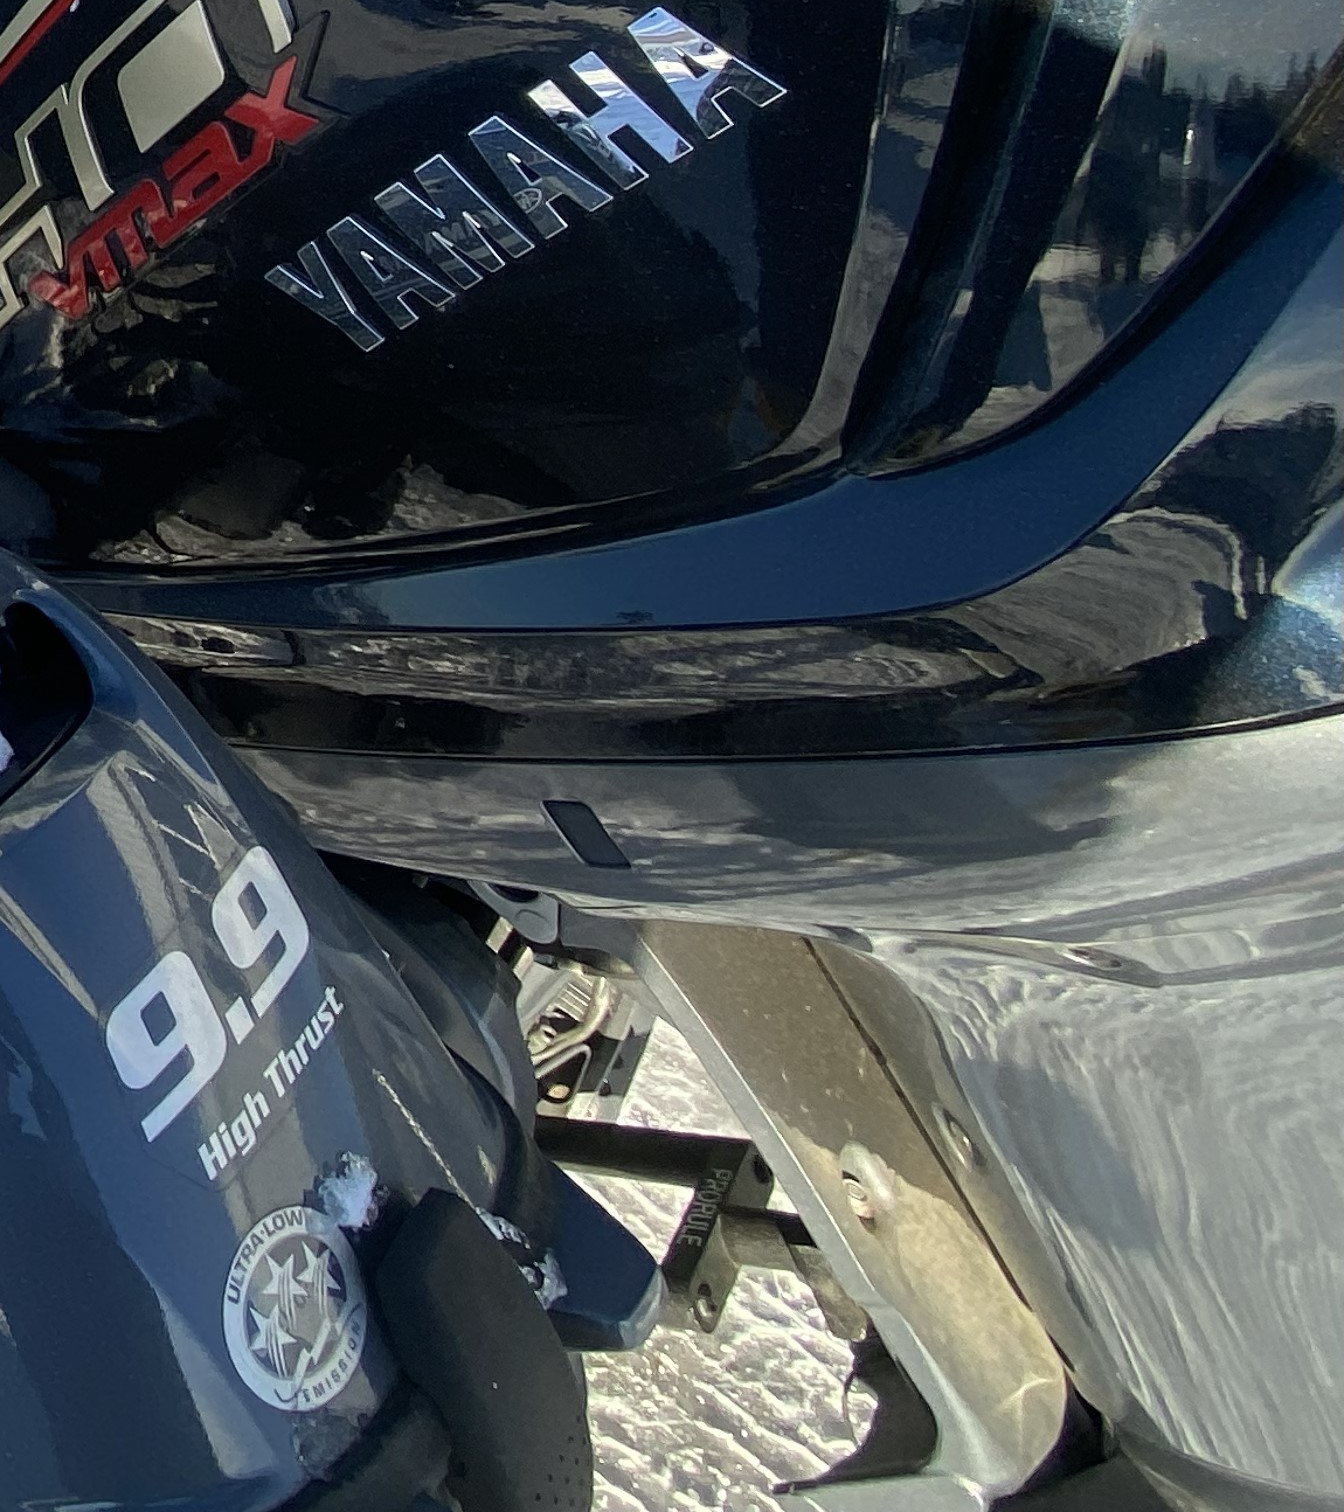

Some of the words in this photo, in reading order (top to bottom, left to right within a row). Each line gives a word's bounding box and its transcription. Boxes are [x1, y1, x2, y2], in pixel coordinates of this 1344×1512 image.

[263, 5, 788, 352] YAMAHA
[105, 845, 310, 1143] 9.9
[196, 1089, 272, 1181] High
[262, 985, 345, 1098] Thrust
